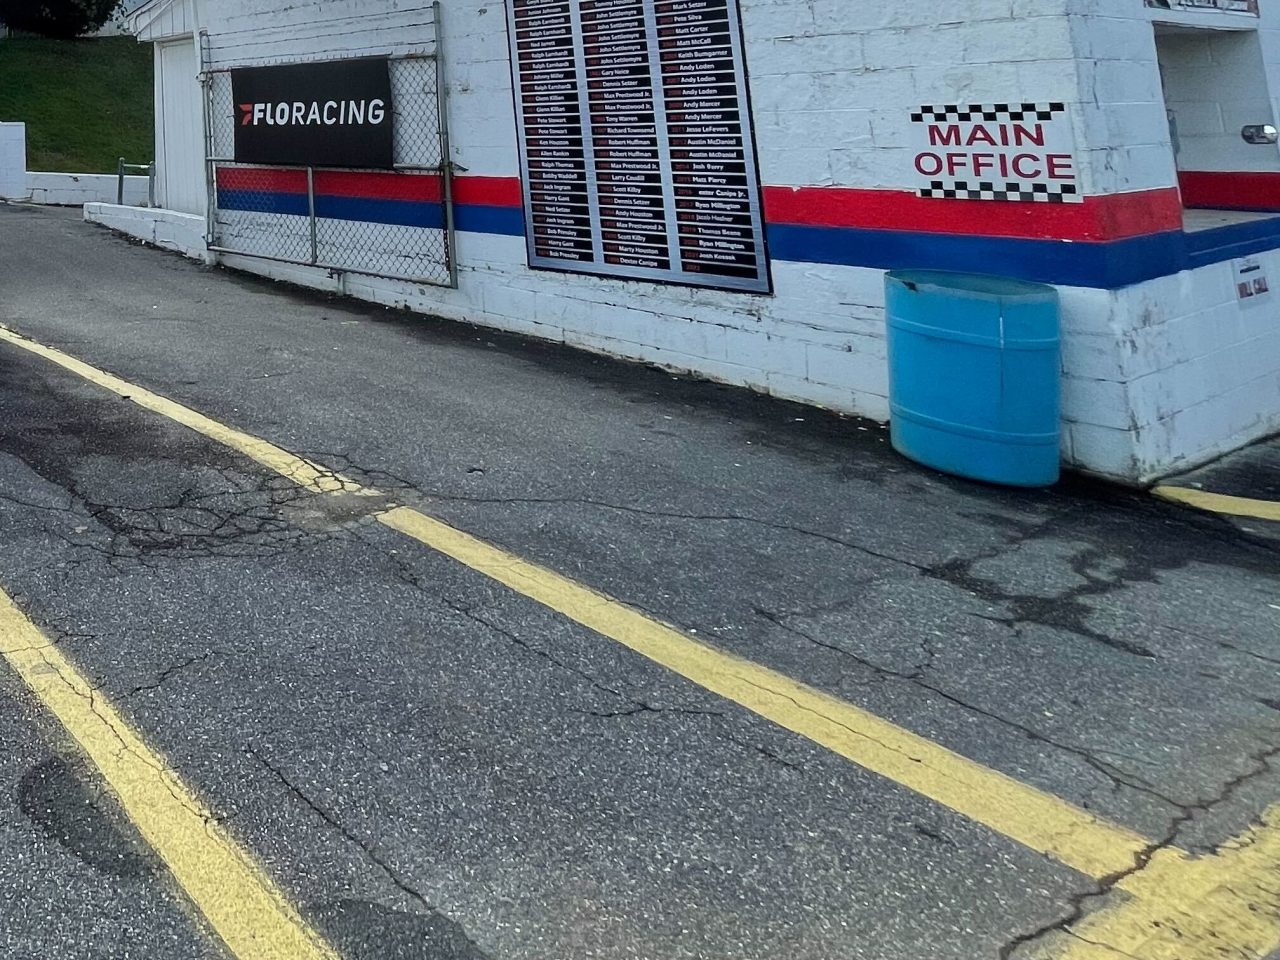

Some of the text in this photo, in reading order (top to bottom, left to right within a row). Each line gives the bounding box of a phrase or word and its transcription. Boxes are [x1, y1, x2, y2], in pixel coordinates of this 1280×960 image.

[682, 88, 697, 96] Andy
[253, 98, 385, 126] FLORACING
[928, 123, 1045, 147] MAIN
[914, 152, 1075, 180] OFFICE
